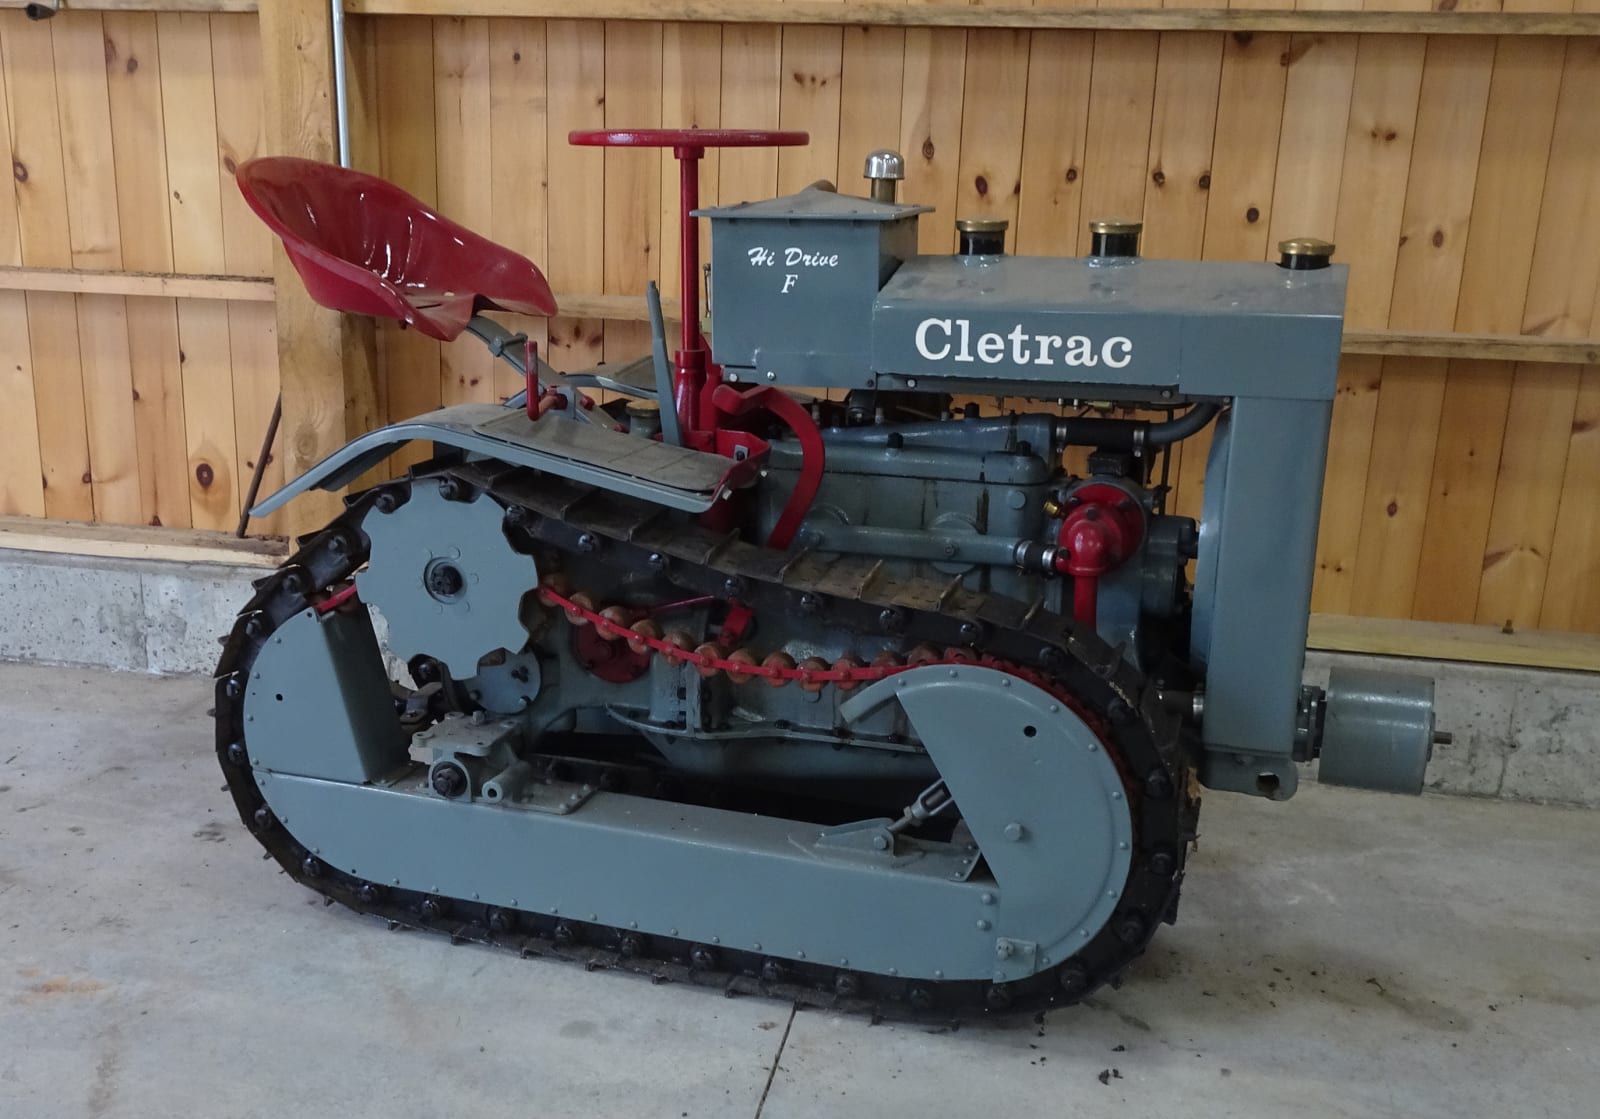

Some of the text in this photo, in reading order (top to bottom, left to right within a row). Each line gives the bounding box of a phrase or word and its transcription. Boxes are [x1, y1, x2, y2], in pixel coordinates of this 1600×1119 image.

[747, 246, 839, 267] Hi Drive
[781, 274, 799, 294] F
[915, 318, 1133, 368] Cletrac
